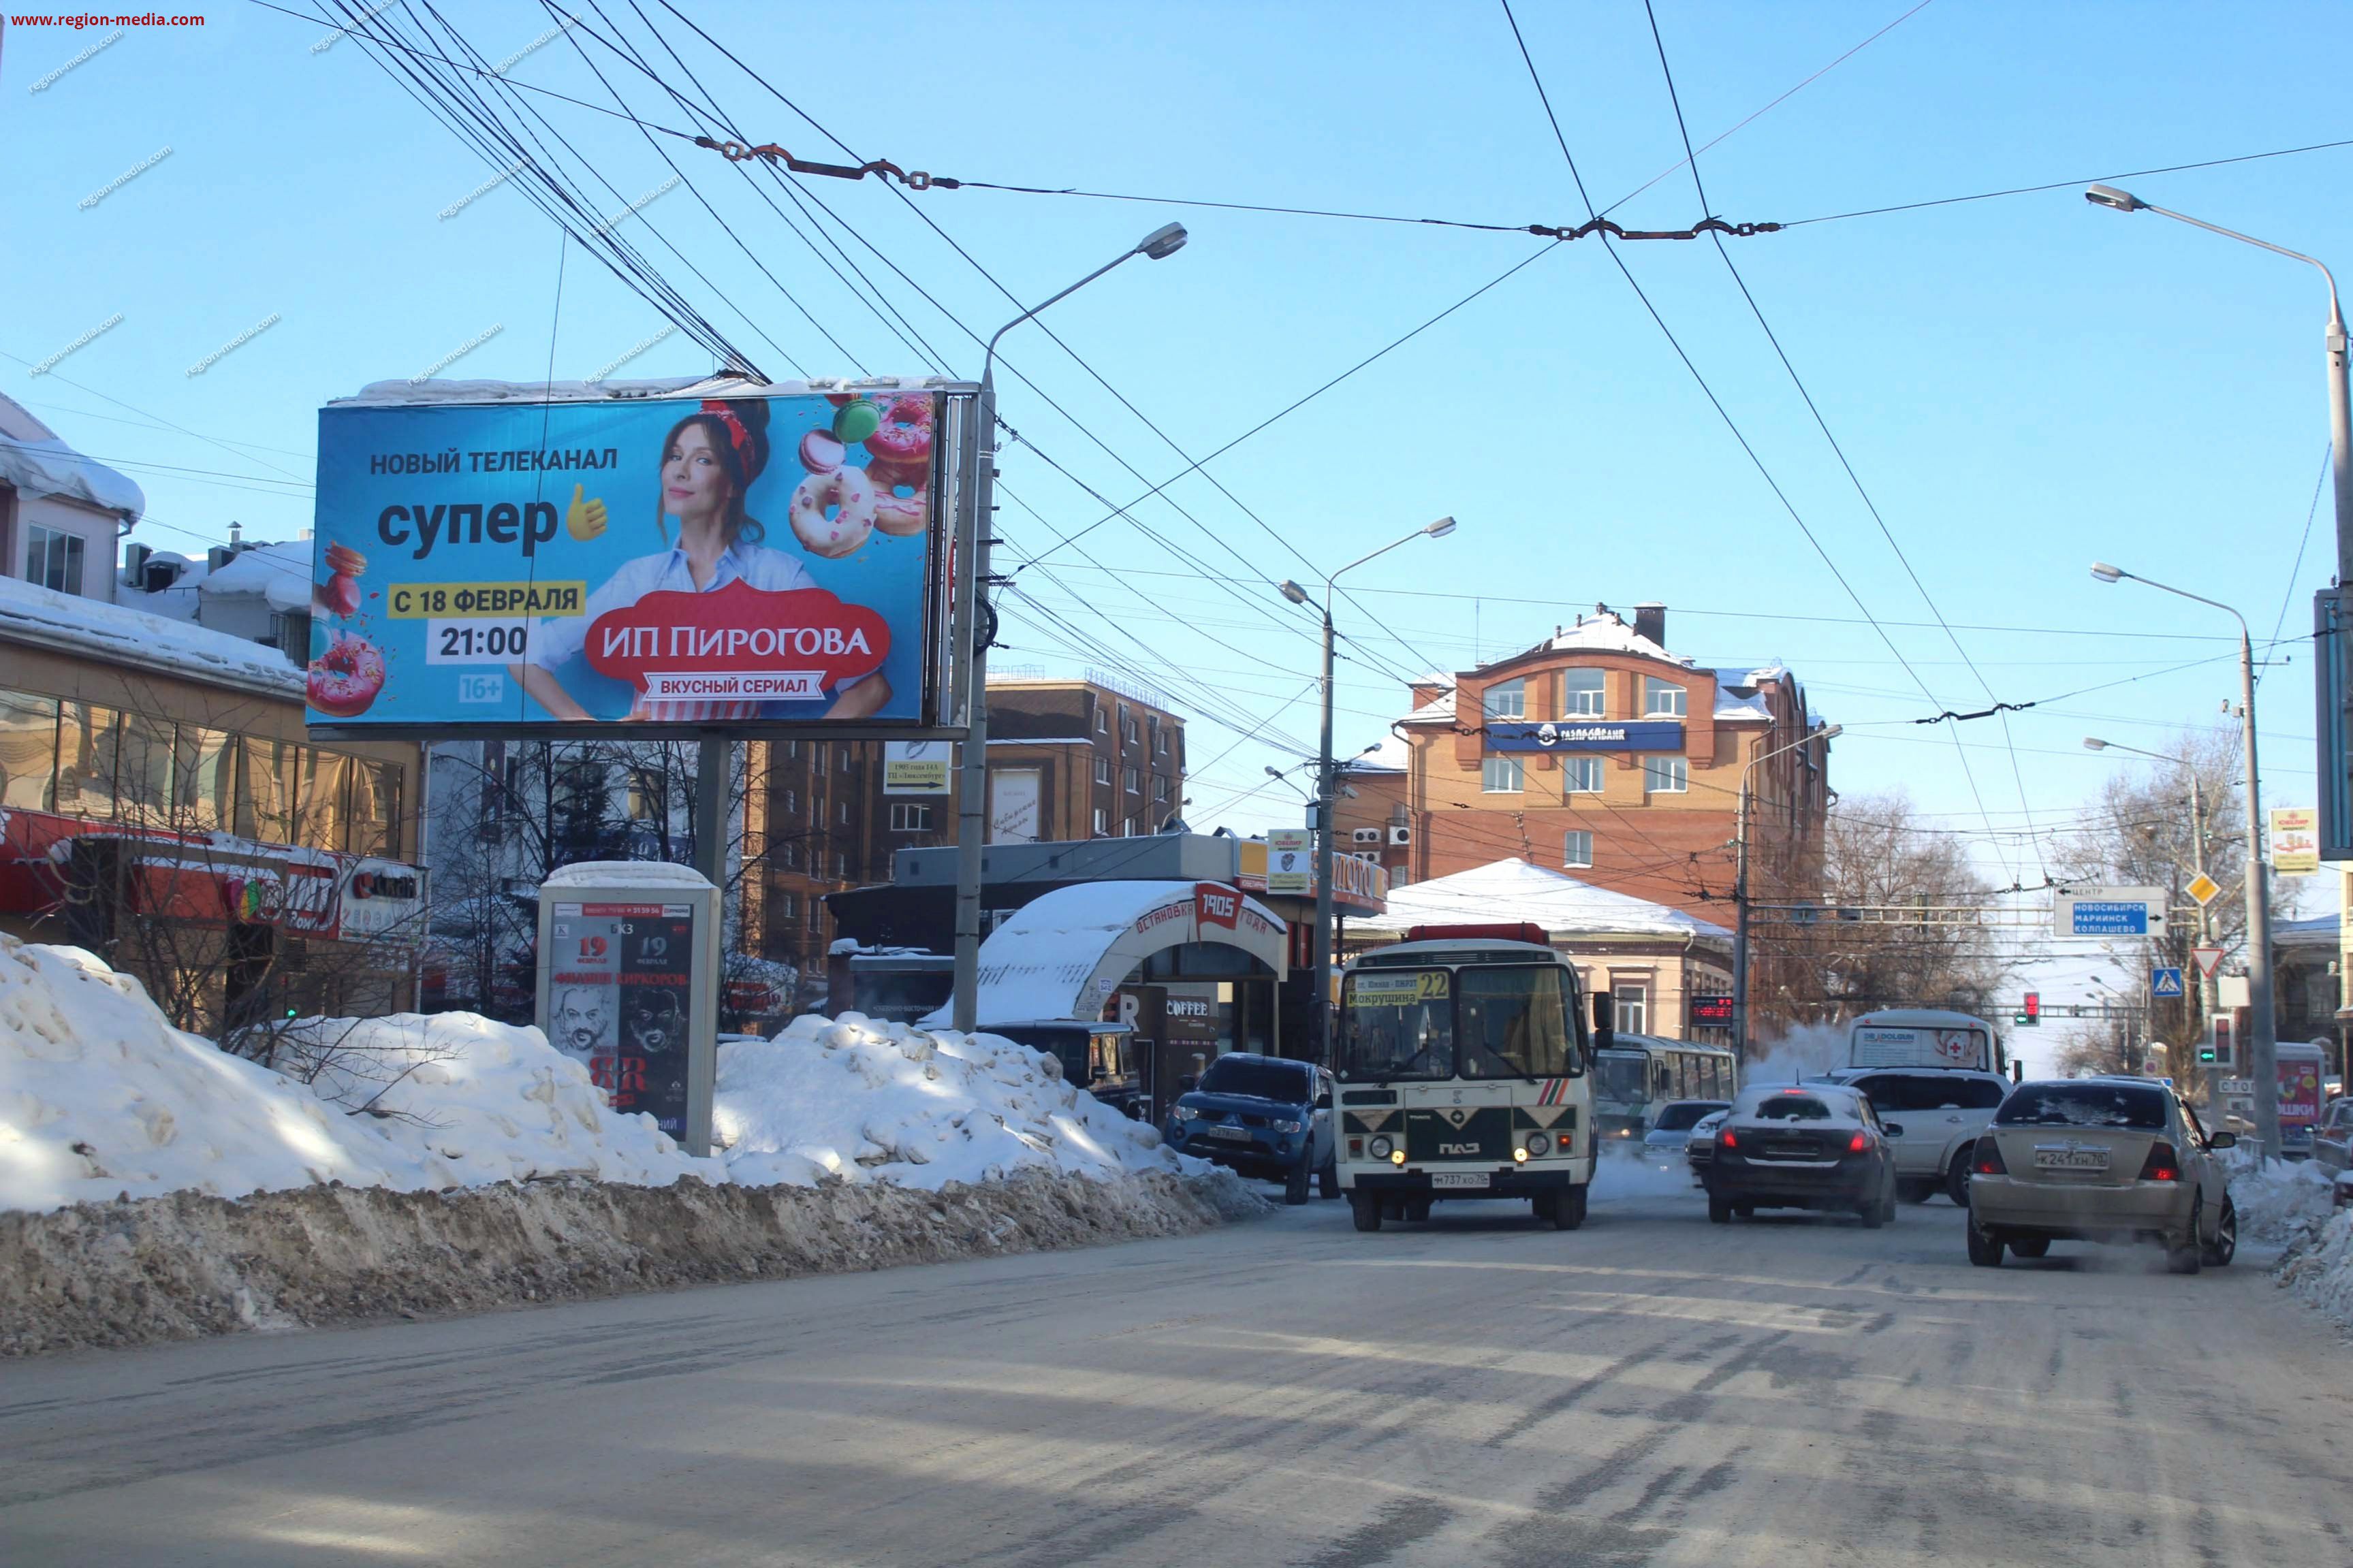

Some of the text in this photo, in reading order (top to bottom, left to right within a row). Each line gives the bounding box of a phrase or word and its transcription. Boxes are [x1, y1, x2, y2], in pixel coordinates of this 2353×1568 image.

[370, 447, 618, 475] НОВЫЙ ТЕЛЕКАНАЛ
[377, 500, 558, 560] супер
[394, 588, 578, 613] С 18 ФЕВРАЛЯ
[440, 626, 527, 656] 21:00
[602, 626, 872, 658] ИП ПИРОГОВА
[462, 678, 501, 699] 16+
[661, 675, 808, 694] ВКУСНЫЙ СЕРИАЛ
[1560, 726, 1625, 741] ГАЗПРОМБАНК
[1136, 894, 1267, 935] ОСТАНОВКА 1905 ГОДА
[579, 936, 608, 957] 19
[640, 936, 667, 957] 19
[616, 973, 687, 985] КИРКОРОВ
[1421, 974, 1447, 997] 22
[1167, 1000, 1207, 1016] COFFEE
[1349, 994, 1415, 1004] Мокрушина
[1439, 1143, 1480, 1154] ПАЗ
